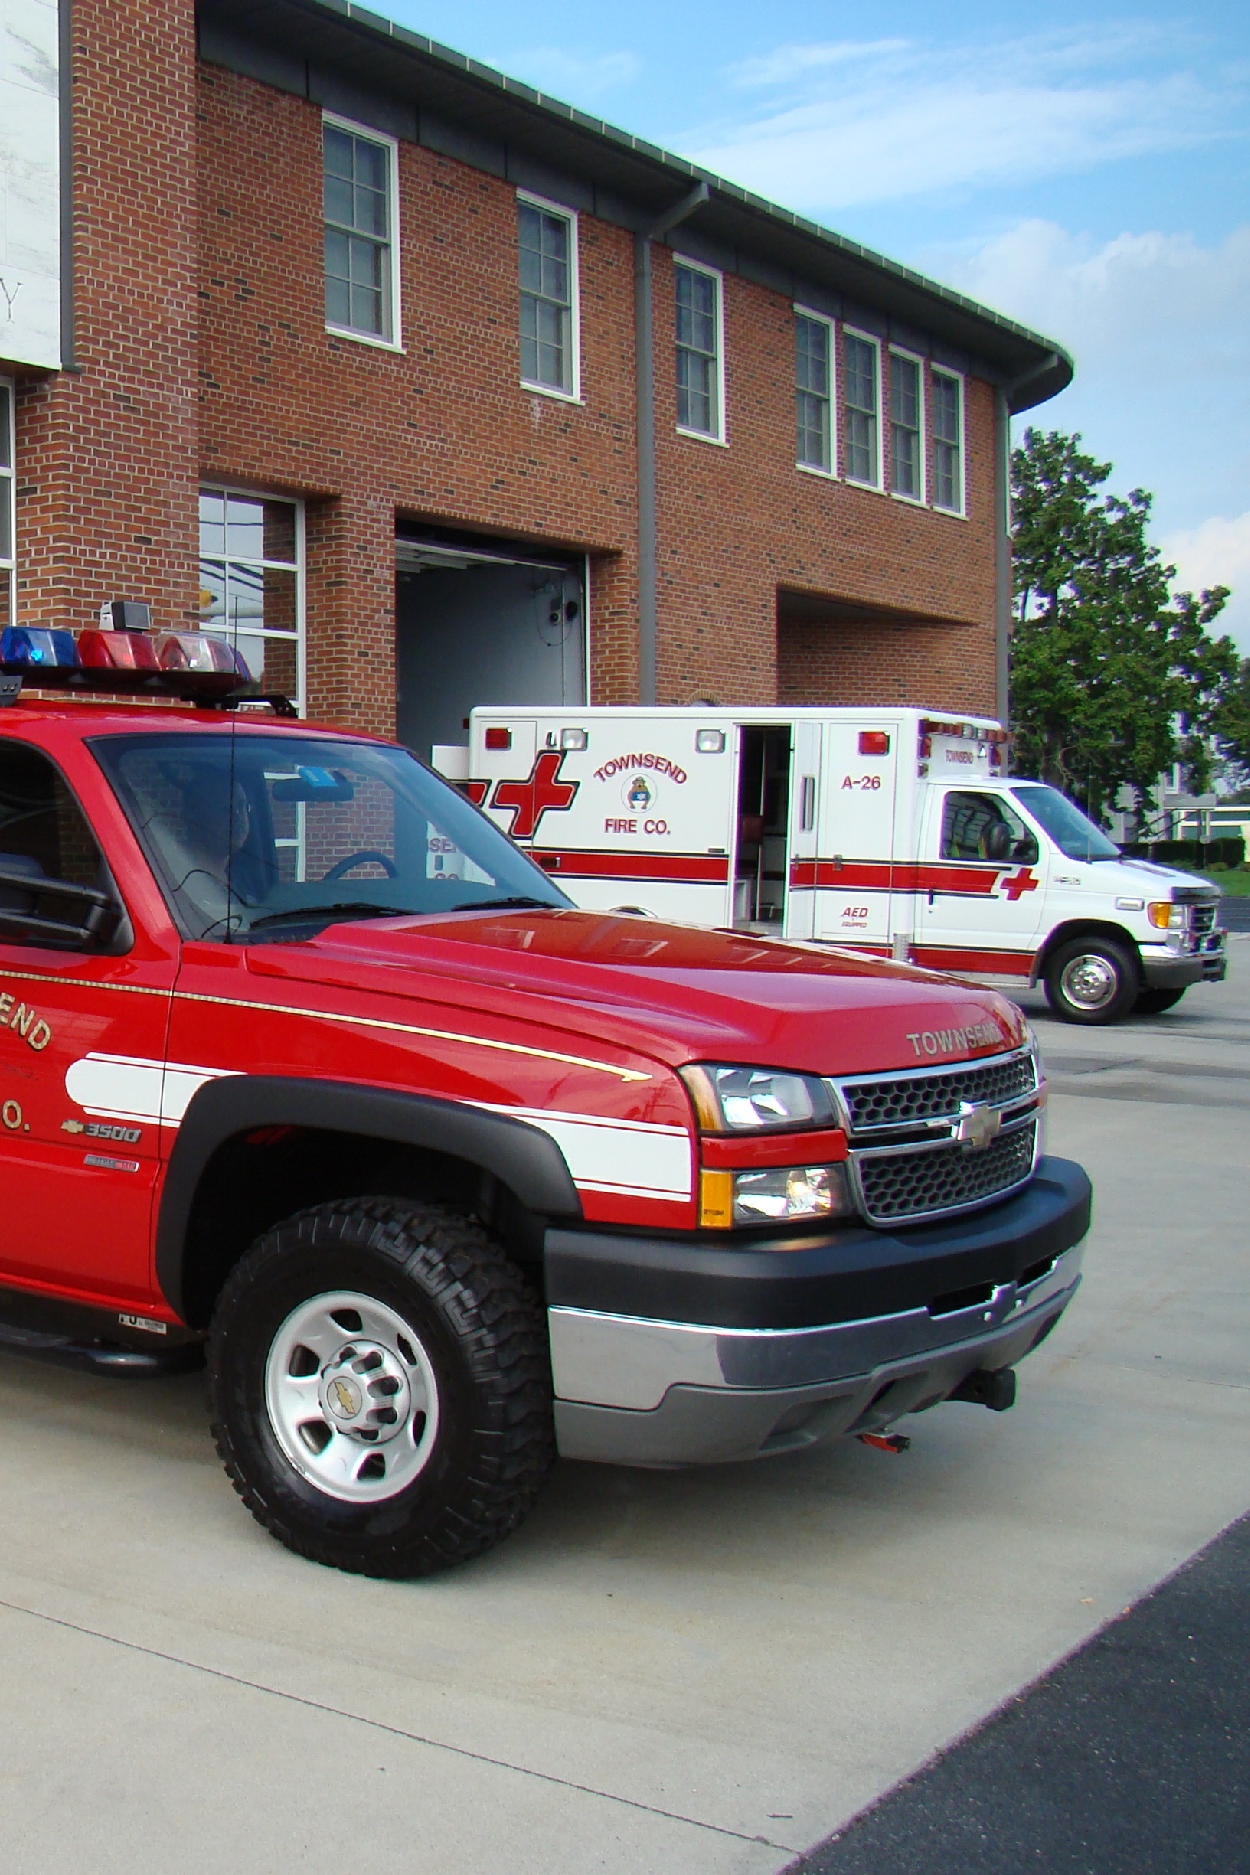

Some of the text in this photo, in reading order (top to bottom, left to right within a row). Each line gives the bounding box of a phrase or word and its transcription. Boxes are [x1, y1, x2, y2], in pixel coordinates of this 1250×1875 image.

[593, 753, 687, 784] TOWNSEND
[841, 775, 881, 790] A-26
[604, 818, 671, 835] FIRE CO.
[841, 907, 868, 918] AED
[906, 1022, 1002, 1056] TOWNSEND
[86, 1124, 141, 1142] 3500
